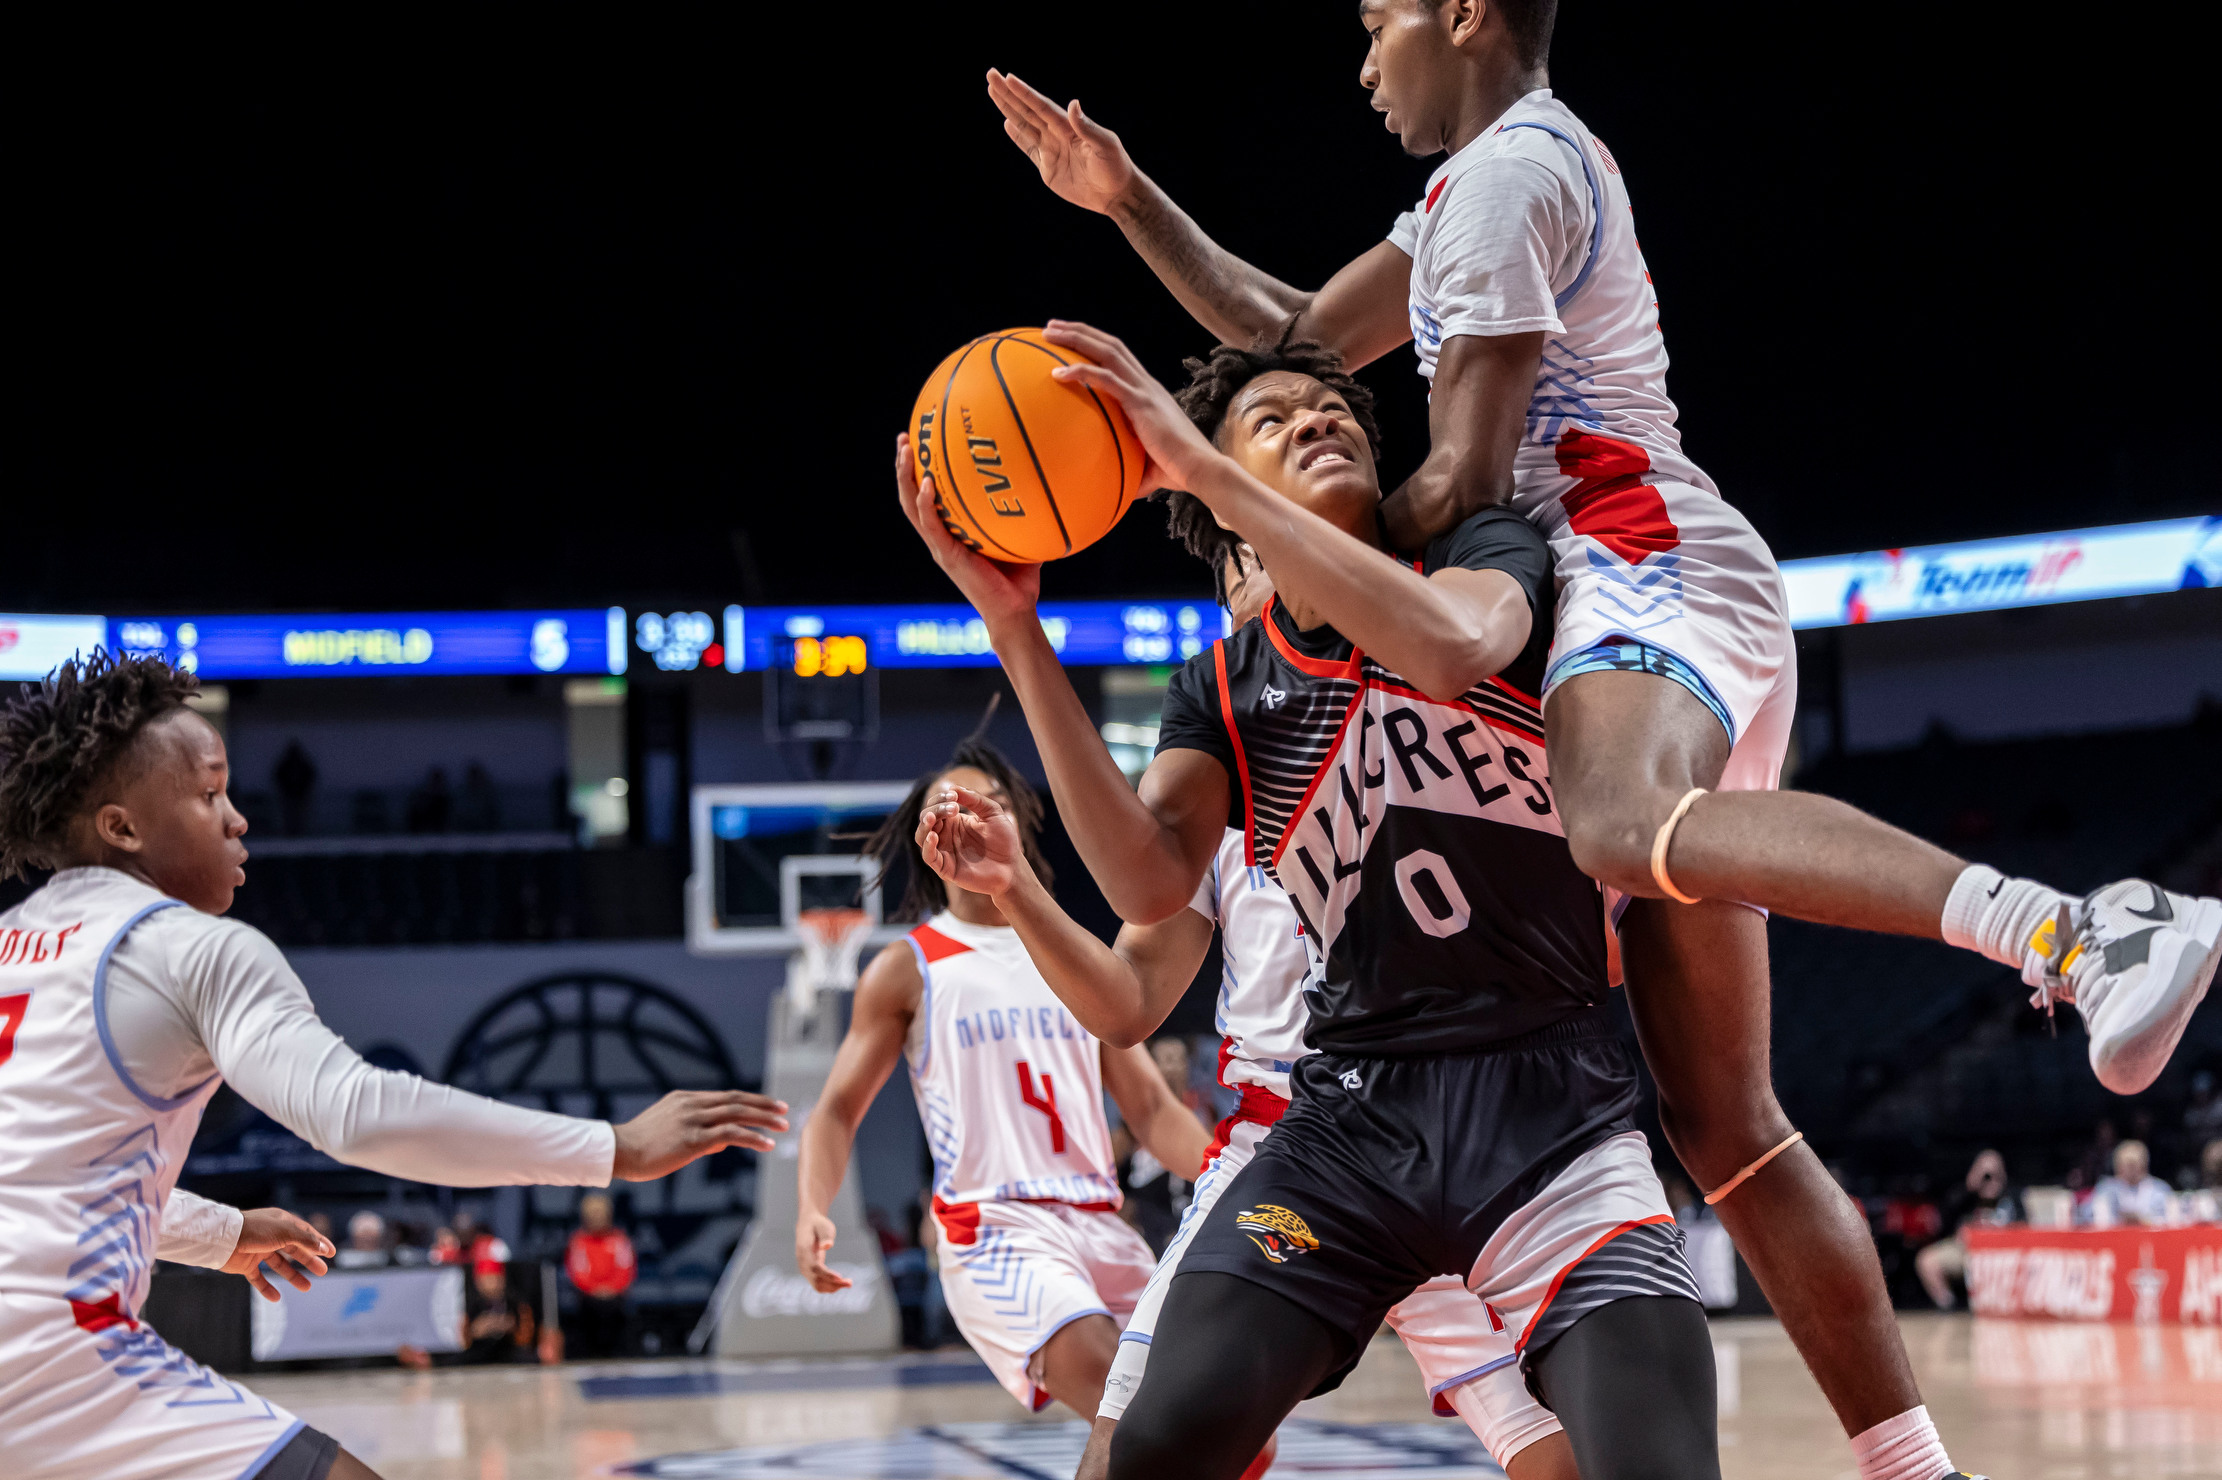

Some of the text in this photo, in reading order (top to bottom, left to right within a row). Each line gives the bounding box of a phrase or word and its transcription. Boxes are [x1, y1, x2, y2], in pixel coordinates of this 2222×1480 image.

[968, 438, 1026, 517] EVO
[284, 628, 433, 666] MIDFIELD
[1288, 706, 1552, 964] HILLCRES
[1394, 848, 1471, 939] 0
[955, 1007, 1088, 1050] MIDFIEL
[1015, 1059, 1067, 1155] 4
